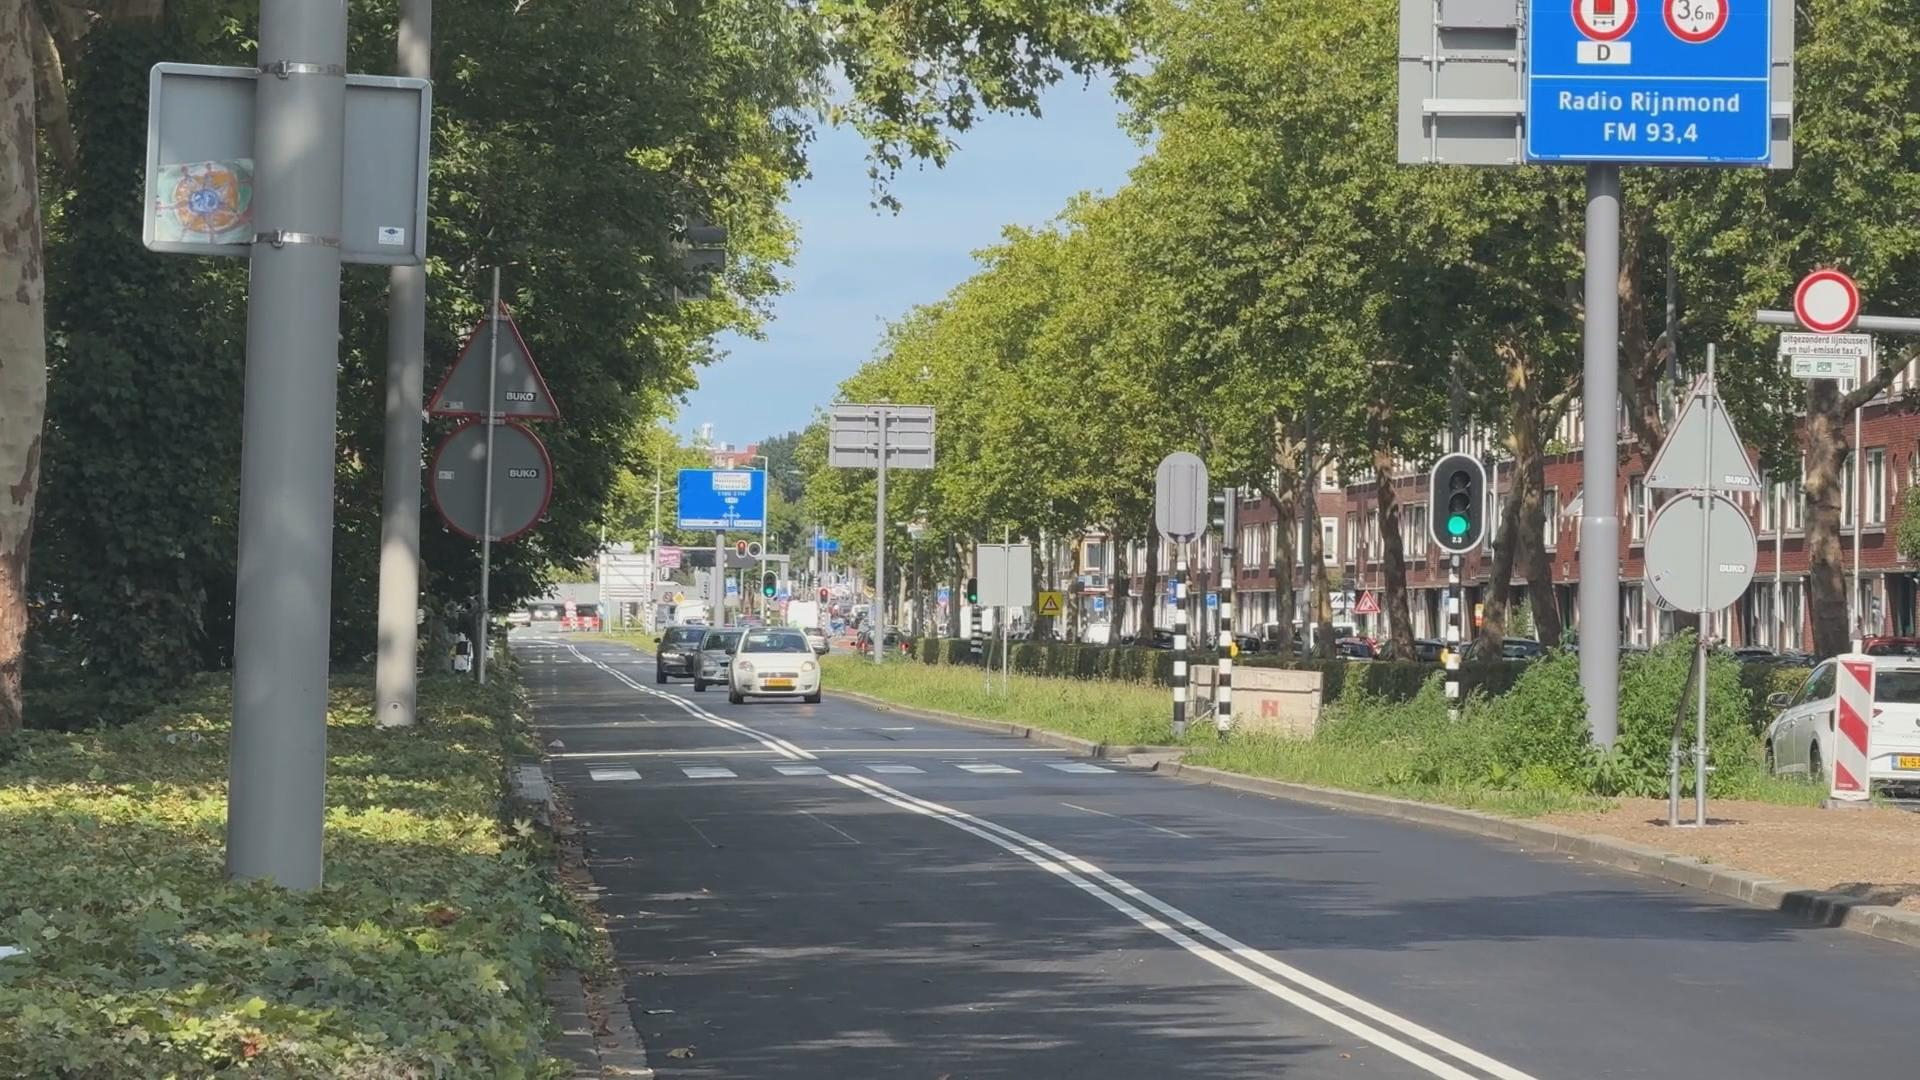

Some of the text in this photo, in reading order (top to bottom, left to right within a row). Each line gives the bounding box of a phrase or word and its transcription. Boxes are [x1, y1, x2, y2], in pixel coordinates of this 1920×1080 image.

[1597, 44, 1611, 61] D
[1559, 91, 1740, 116] Radio Rijnmond
[1603, 122, 1698, 144] FM 93,4
[1782, 335, 1868, 345] uitgezonderd lijnbussen
[1799, 346, 1841, 354] nul-emissie
[506, 392, 534, 401] BUKO
[509, 469, 537, 478] BUKO
[1724, 475, 1750, 485] BUKO
[1719, 564, 1745, 573] BUKO
[1900, 757, 1920, 768] N-5
